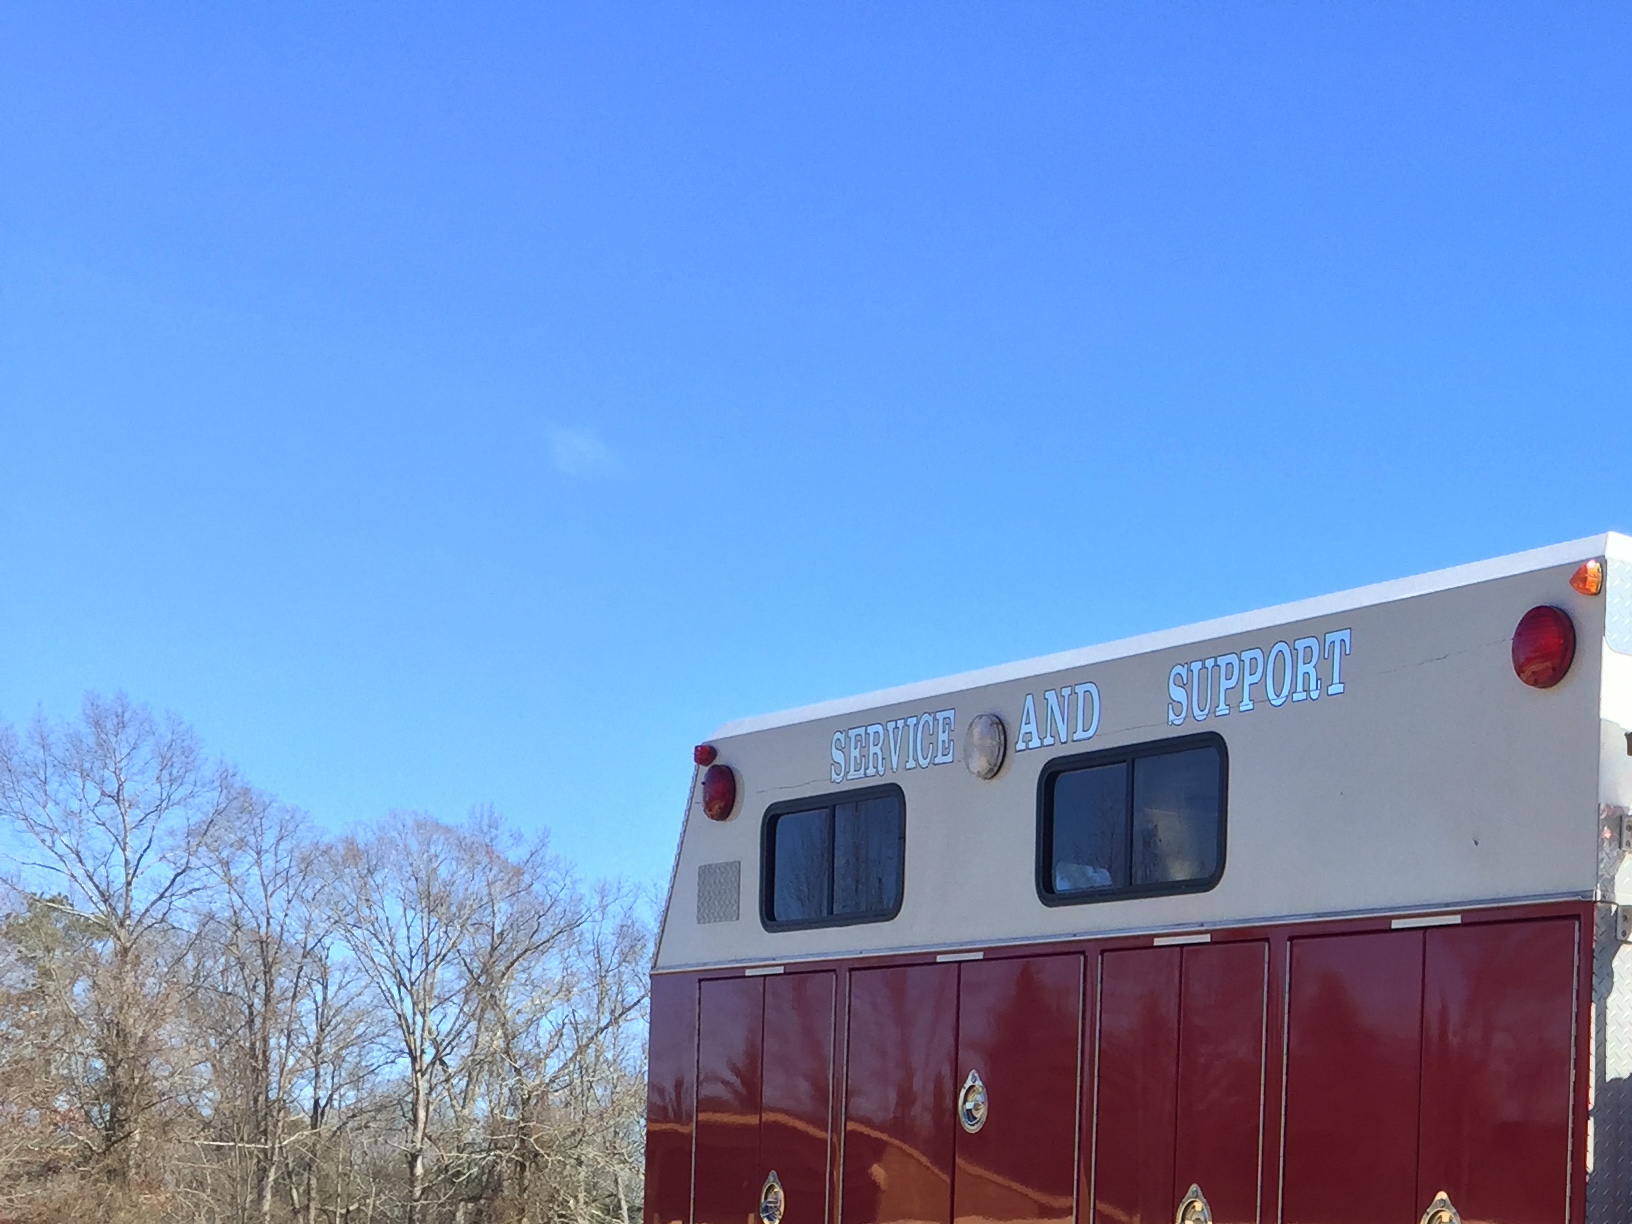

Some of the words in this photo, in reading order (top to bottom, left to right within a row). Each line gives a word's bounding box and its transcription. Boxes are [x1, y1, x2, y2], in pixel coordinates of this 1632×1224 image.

[830, 708, 956, 783] SERVICE
[1015, 682, 1100, 752] AND
[1168, 628, 1352, 726] SUPPORT
